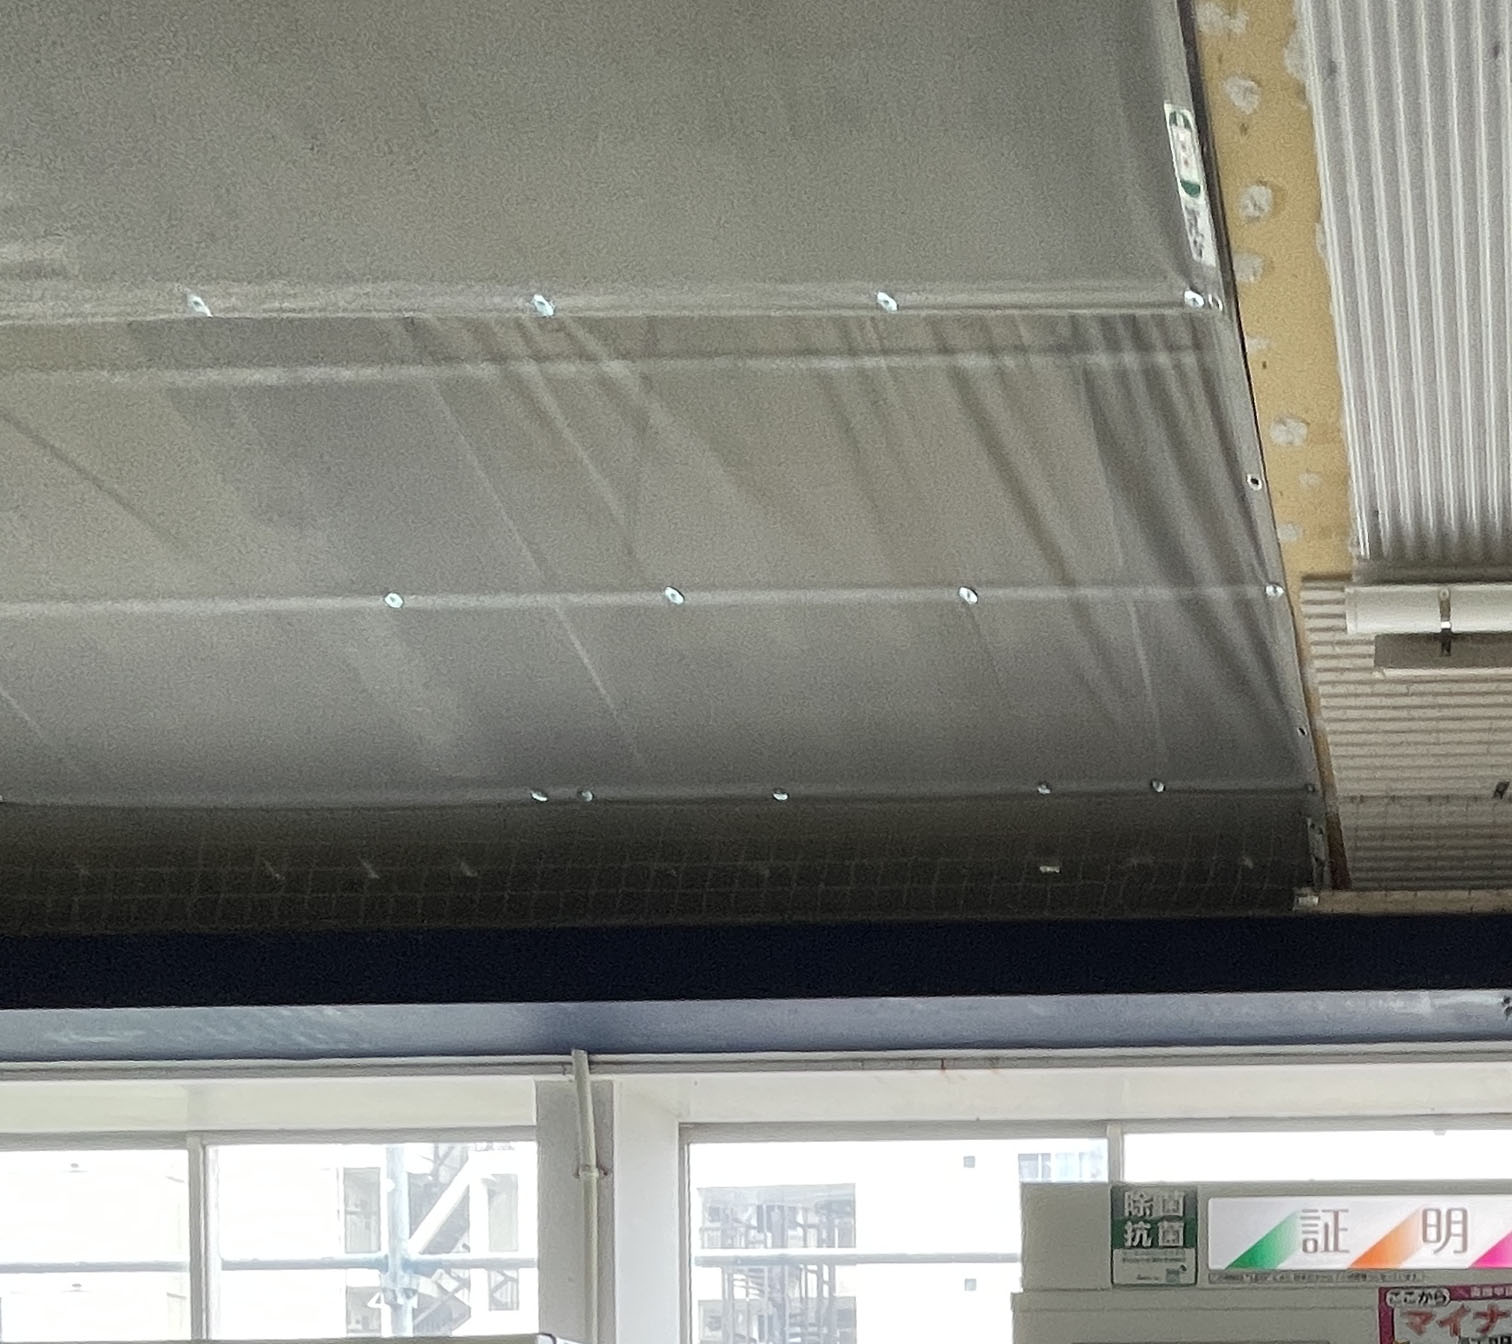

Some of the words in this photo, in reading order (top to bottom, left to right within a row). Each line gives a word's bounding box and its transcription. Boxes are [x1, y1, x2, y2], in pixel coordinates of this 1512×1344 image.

[1124, 1191, 1184, 1216] 除菌
[1124, 1221, 1184, 1247] 抗菌
[1389, 1291, 1447, 1306] ここから
